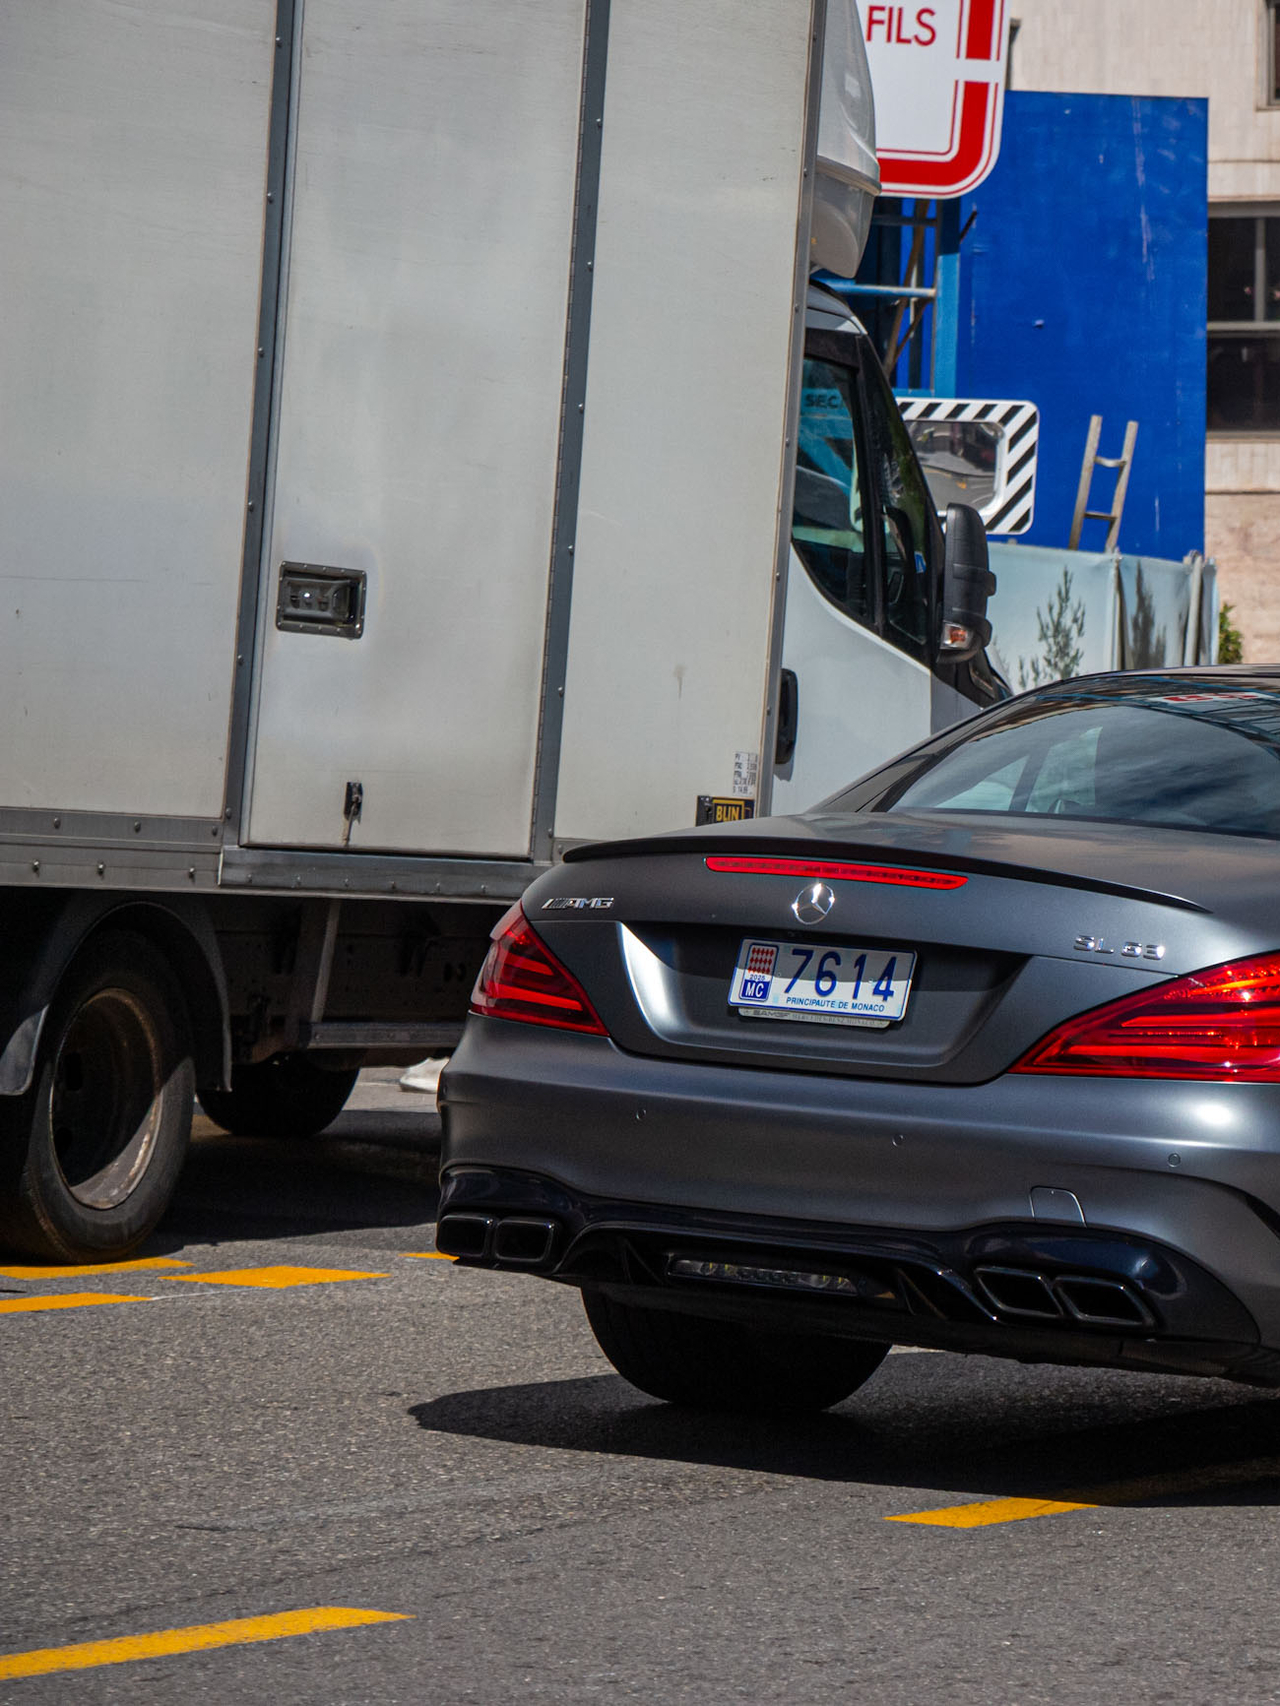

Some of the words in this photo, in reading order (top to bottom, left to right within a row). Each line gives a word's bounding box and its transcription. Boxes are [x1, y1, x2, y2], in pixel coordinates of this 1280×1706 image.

[866, 5, 937, 47] FILS
[717, 805, 740, 821] BLIN
[562, 897, 614, 909] AMG
[1073, 935, 1114, 954] SL
[1121, 941, 1165, 960] 63
[784, 948, 897, 1002] 7614
[745, 983, 765, 998] MC
[786, 997, 836, 1009] PRINCIPAUTE
[838, 1001, 848, 1009] DE
[851, 1002, 885, 1013] MONACO
